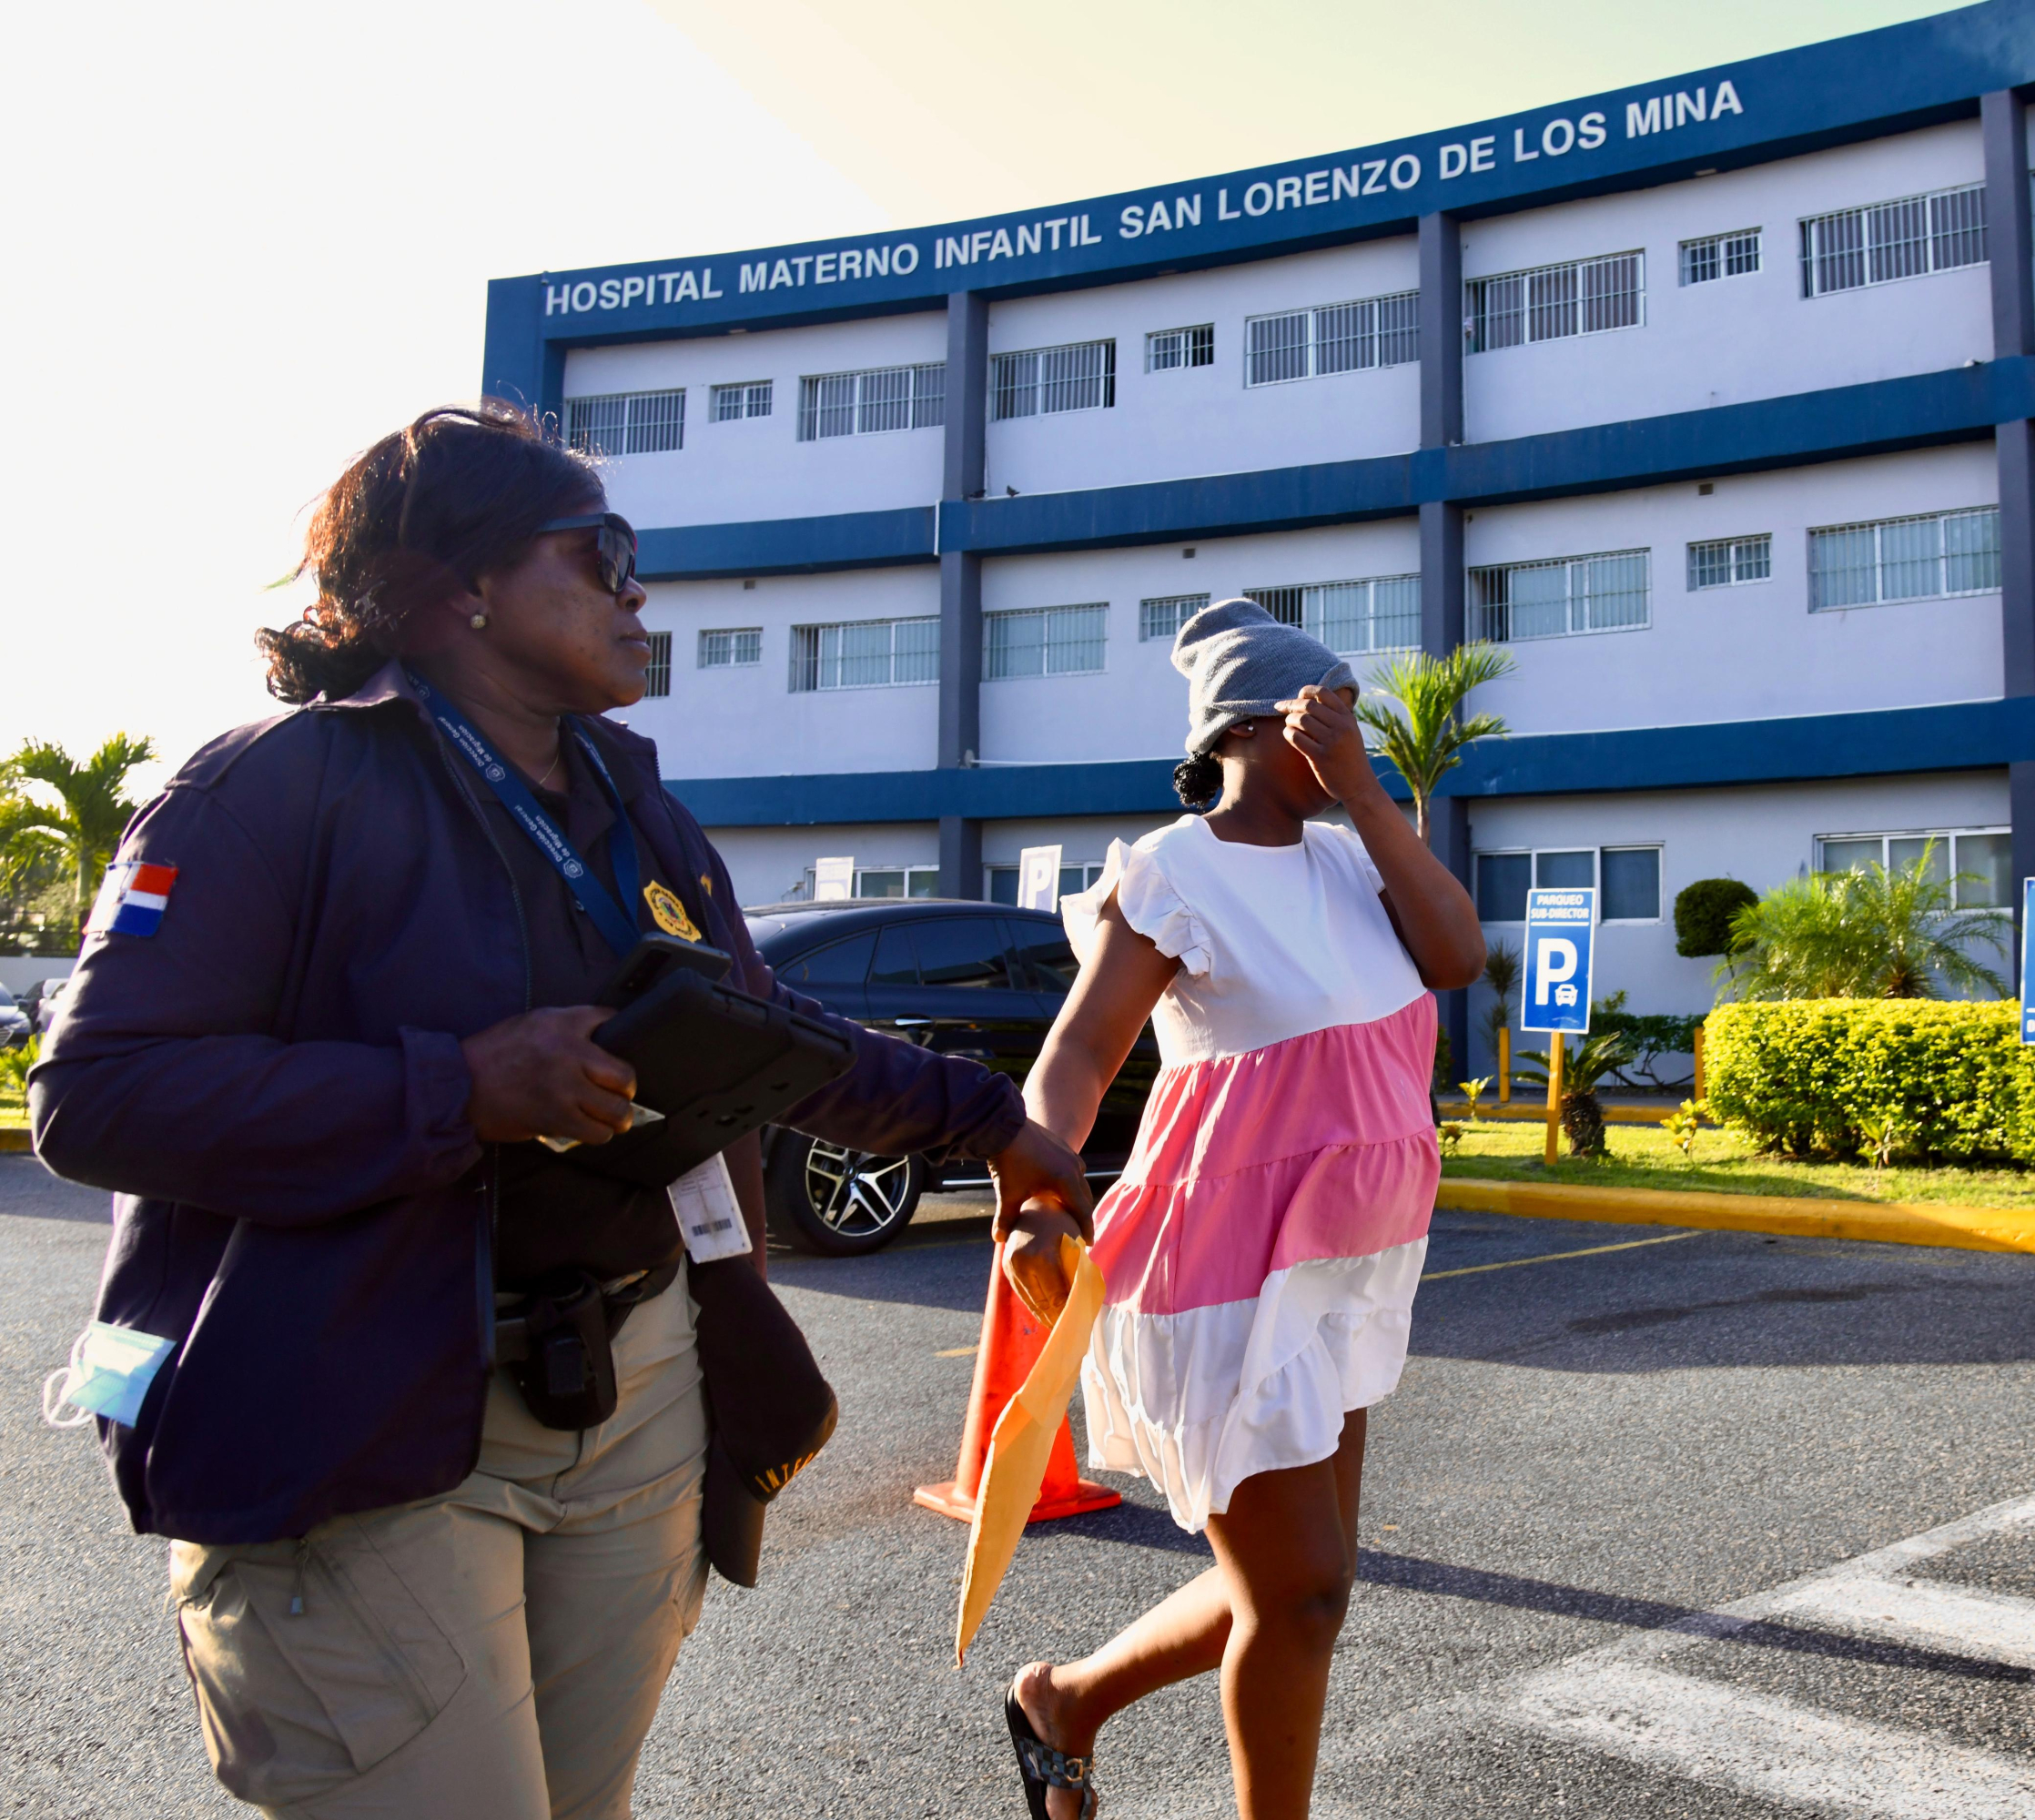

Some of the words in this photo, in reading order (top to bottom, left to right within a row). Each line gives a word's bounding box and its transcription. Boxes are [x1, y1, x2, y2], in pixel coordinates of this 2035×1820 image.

[546, 268, 723, 315] HOSPITAL
[739, 243, 918, 293] MATERNO
[935, 214, 1101, 268] INFANTIL
[1119, 194, 1200, 238] SAN
[1219, 154, 1421, 220] LORENZO
[1440, 136, 1495, 179] DE
[1514, 112, 1606, 162] LOS
[1626, 80, 1743, 138] MINA
[1026, 857, 1053, 910] P
[1536, 894, 1584, 905] PARQUEO
[1530, 907, 1589, 919] SUB-DIRECTOR
[1534, 937, 1578, 1006] P
